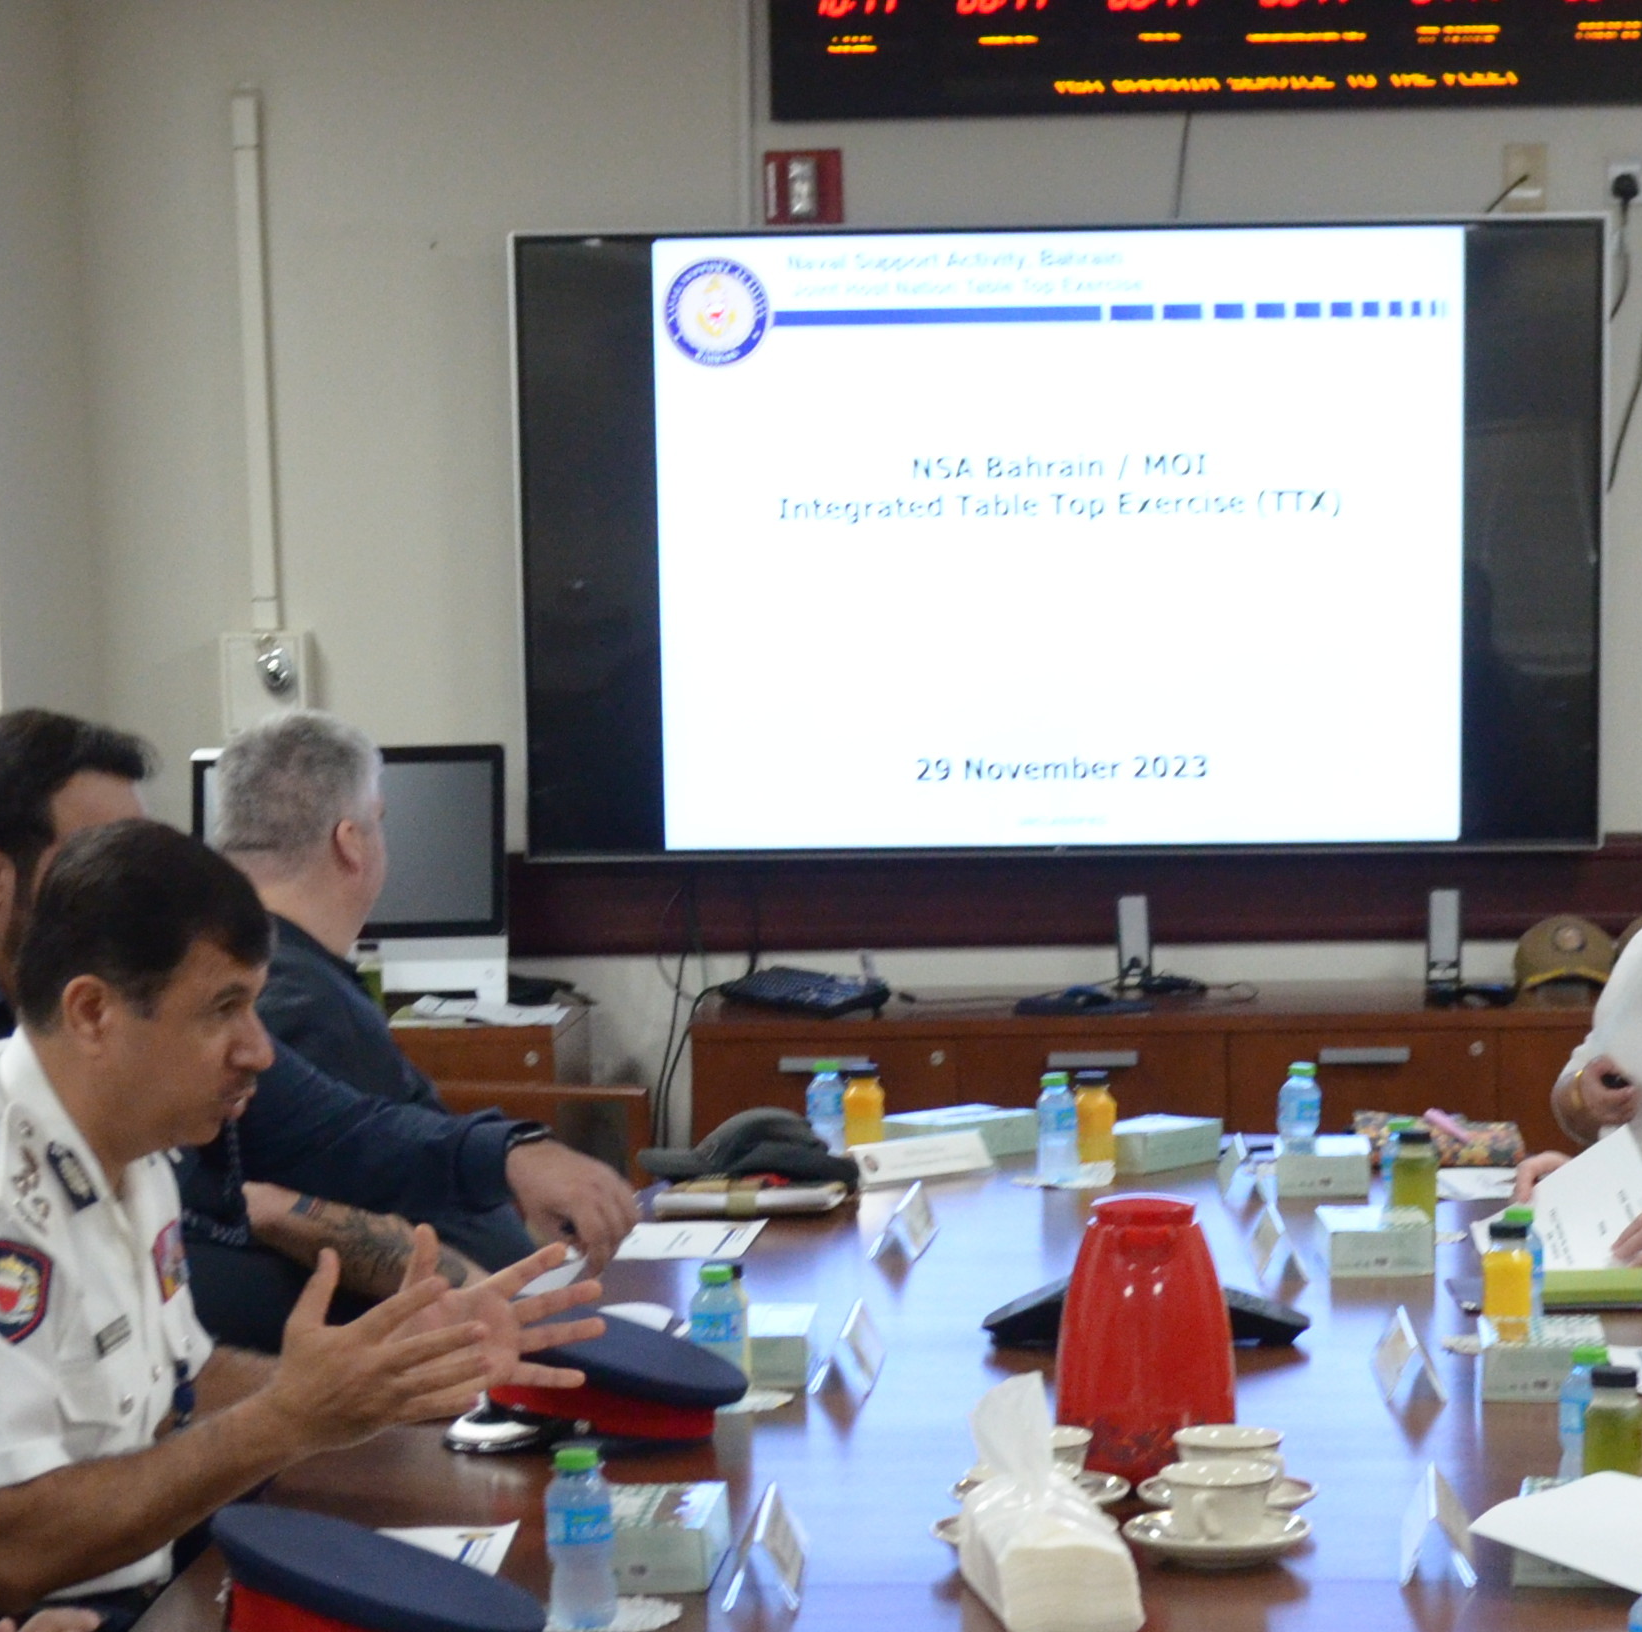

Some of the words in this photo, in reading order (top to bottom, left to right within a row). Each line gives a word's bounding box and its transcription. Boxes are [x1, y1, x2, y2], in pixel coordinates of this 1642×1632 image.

[912, 456, 972, 480] NSA
[986, 455, 1104, 479] Bahrain
[1143, 453, 1207, 477] MOI
[778, 495, 945, 525] Integrated
[956, 494, 1039, 517] Table
[1049, 493, 1106, 521] Top
[1117, 492, 1246, 516] Exercise
[1256, 488, 1342, 518] (TTX)
[915, 757, 952, 782] 29
[964, 756, 1121, 781] November
[1132, 754, 1208, 779] 2023
